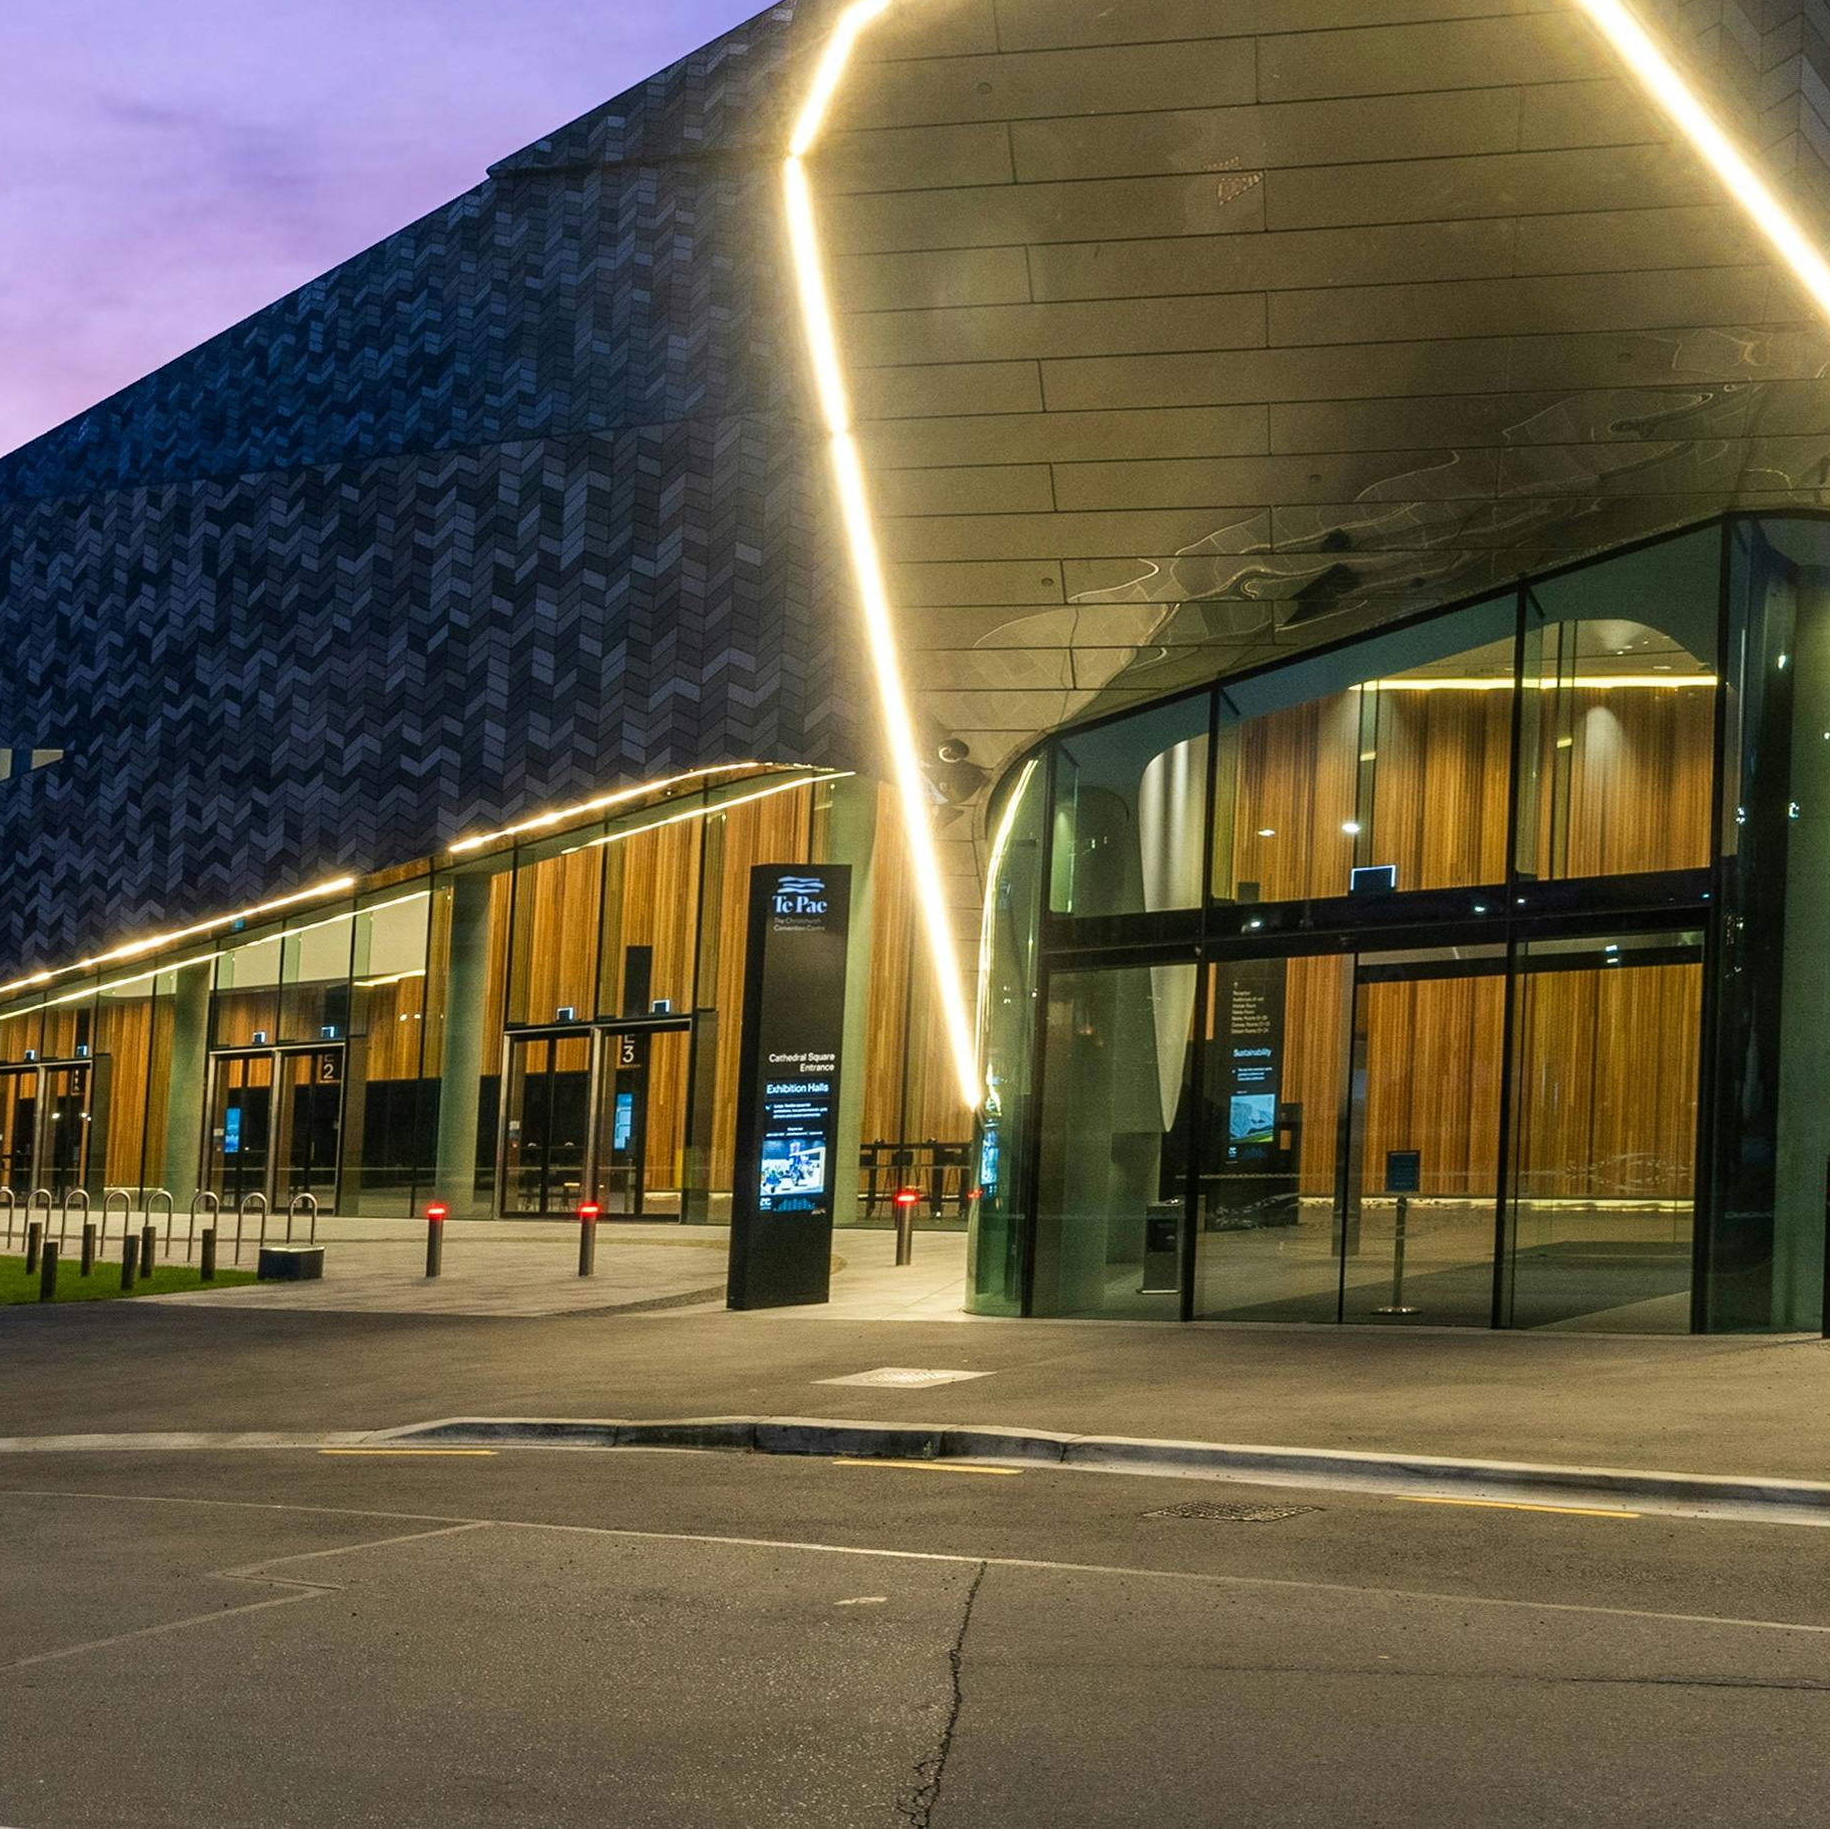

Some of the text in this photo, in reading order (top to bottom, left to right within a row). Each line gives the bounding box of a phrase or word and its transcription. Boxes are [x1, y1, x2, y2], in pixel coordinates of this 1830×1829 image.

[772, 895, 828, 913] Te Pae
[622, 1045, 635, 1063] 3
[768, 1052, 835, 1062] Cathedral Square
[323, 1063, 334, 1079] 2
[799, 1063, 835, 1072] Entrance
[766, 1082, 829, 1094] Exhibition Halls
